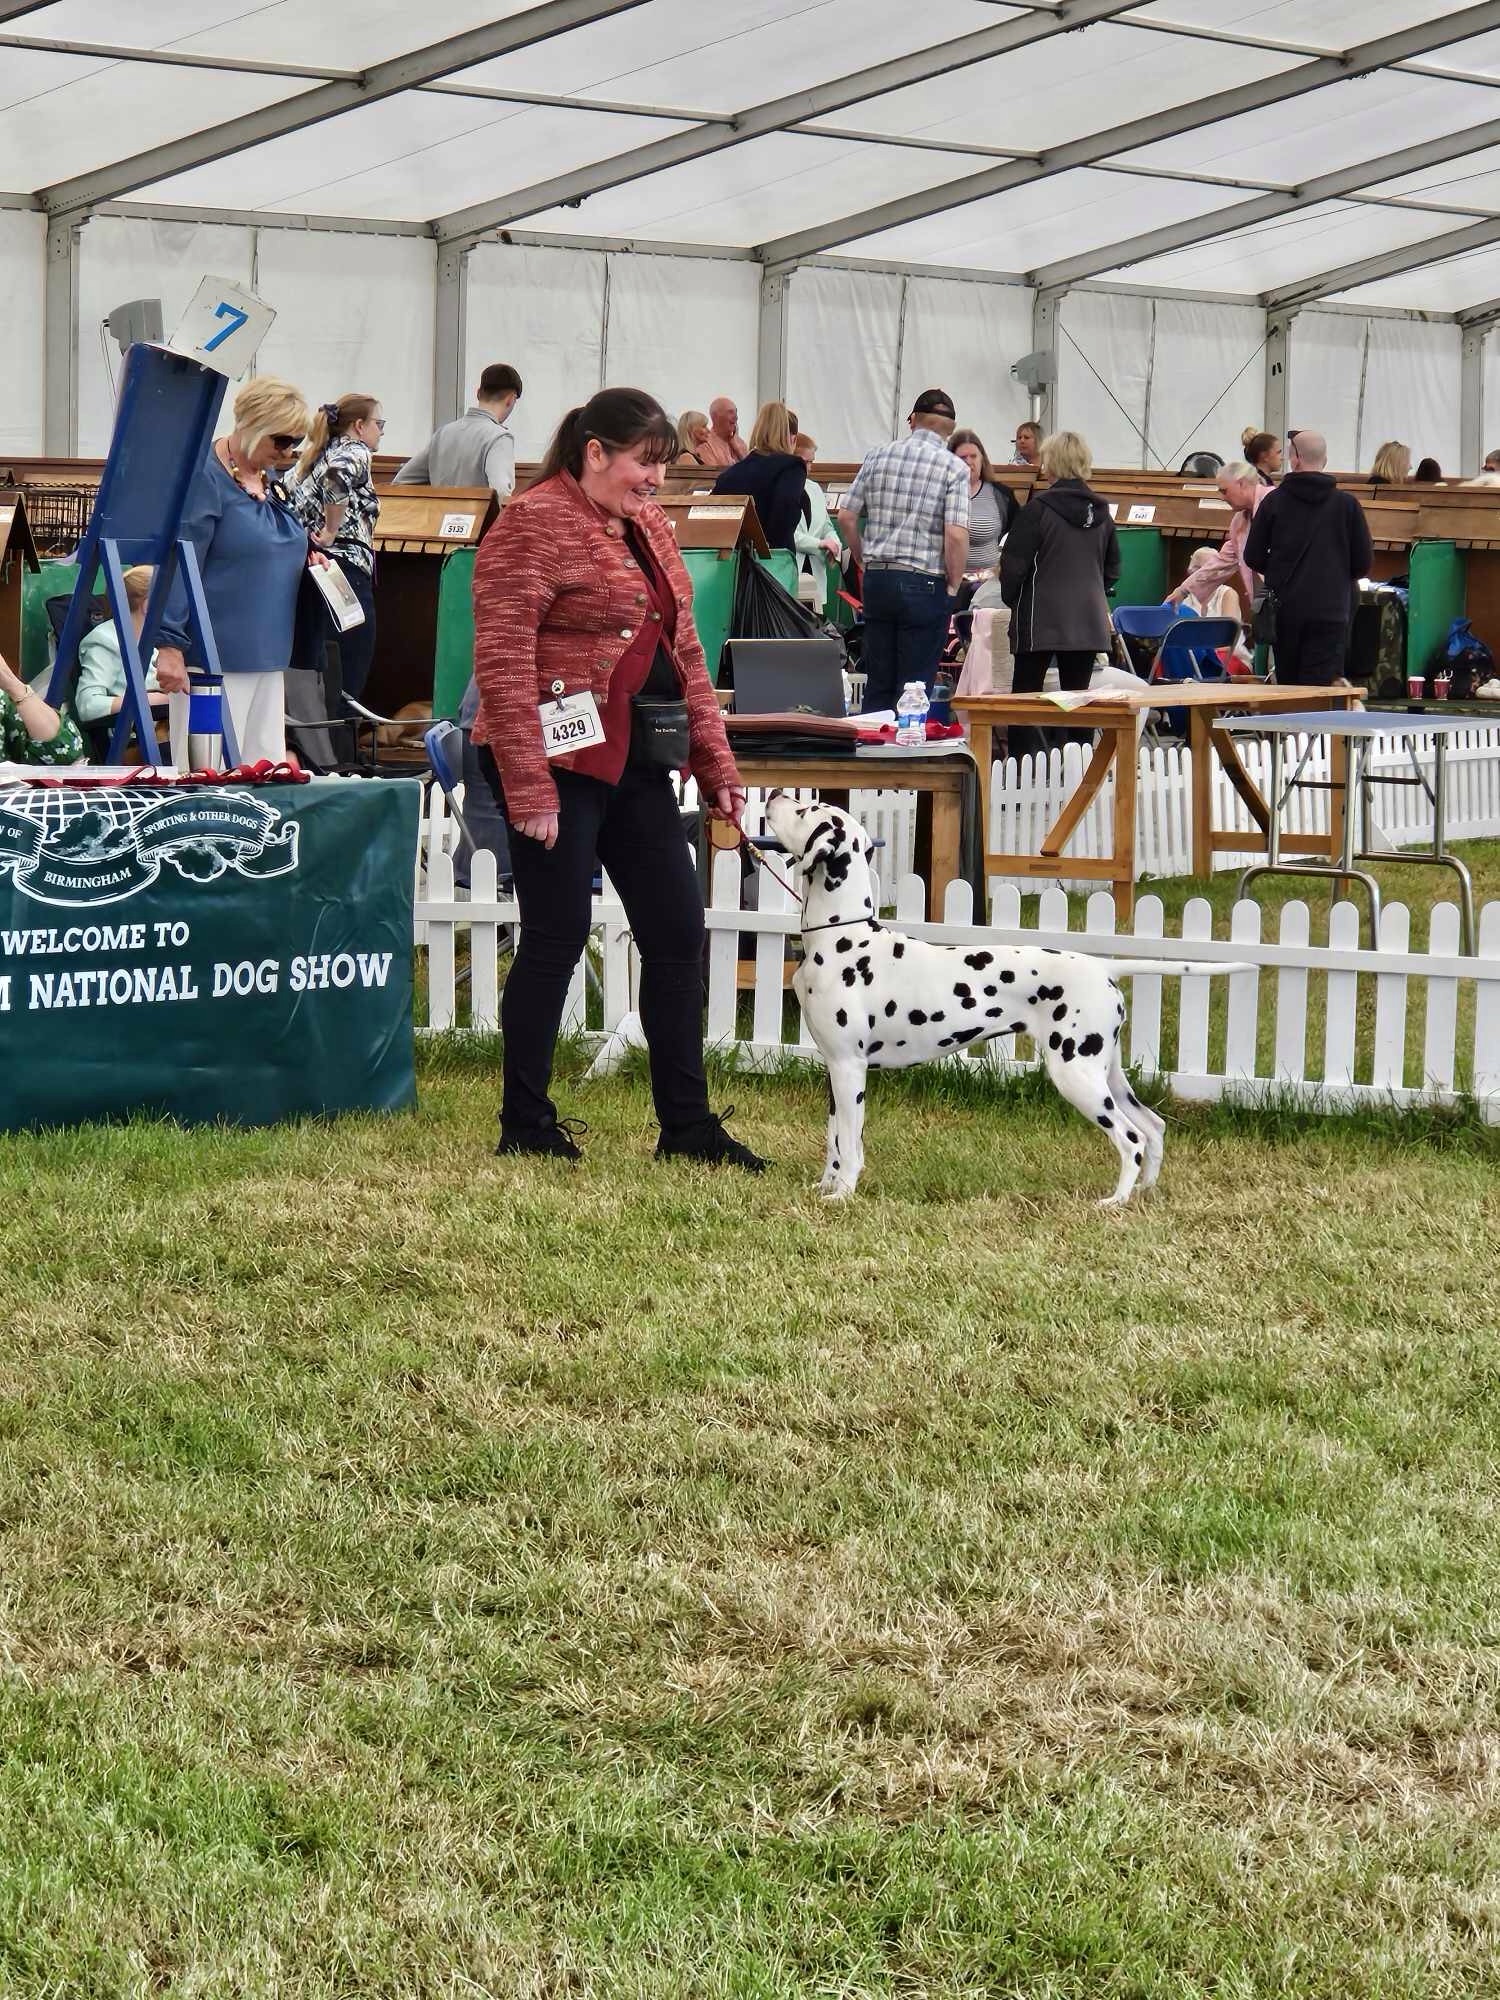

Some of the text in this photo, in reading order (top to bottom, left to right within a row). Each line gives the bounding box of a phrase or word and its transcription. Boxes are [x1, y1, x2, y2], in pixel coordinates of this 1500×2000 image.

[204, 301, 249, 352] 7
[552, 719, 587, 742] 4329
[7, 827, 23, 839] OF
[143, 811, 259, 837] SPORTING & OTHER DOGS
[43, 866, 132, 889] BIRMINGHAM
[0, 921, 190, 956] WELCOME TO
[28, 965, 199, 1010] NATIONAL
[212, 958, 280, 998] DOG
[289, 952, 393, 992] SHOW
